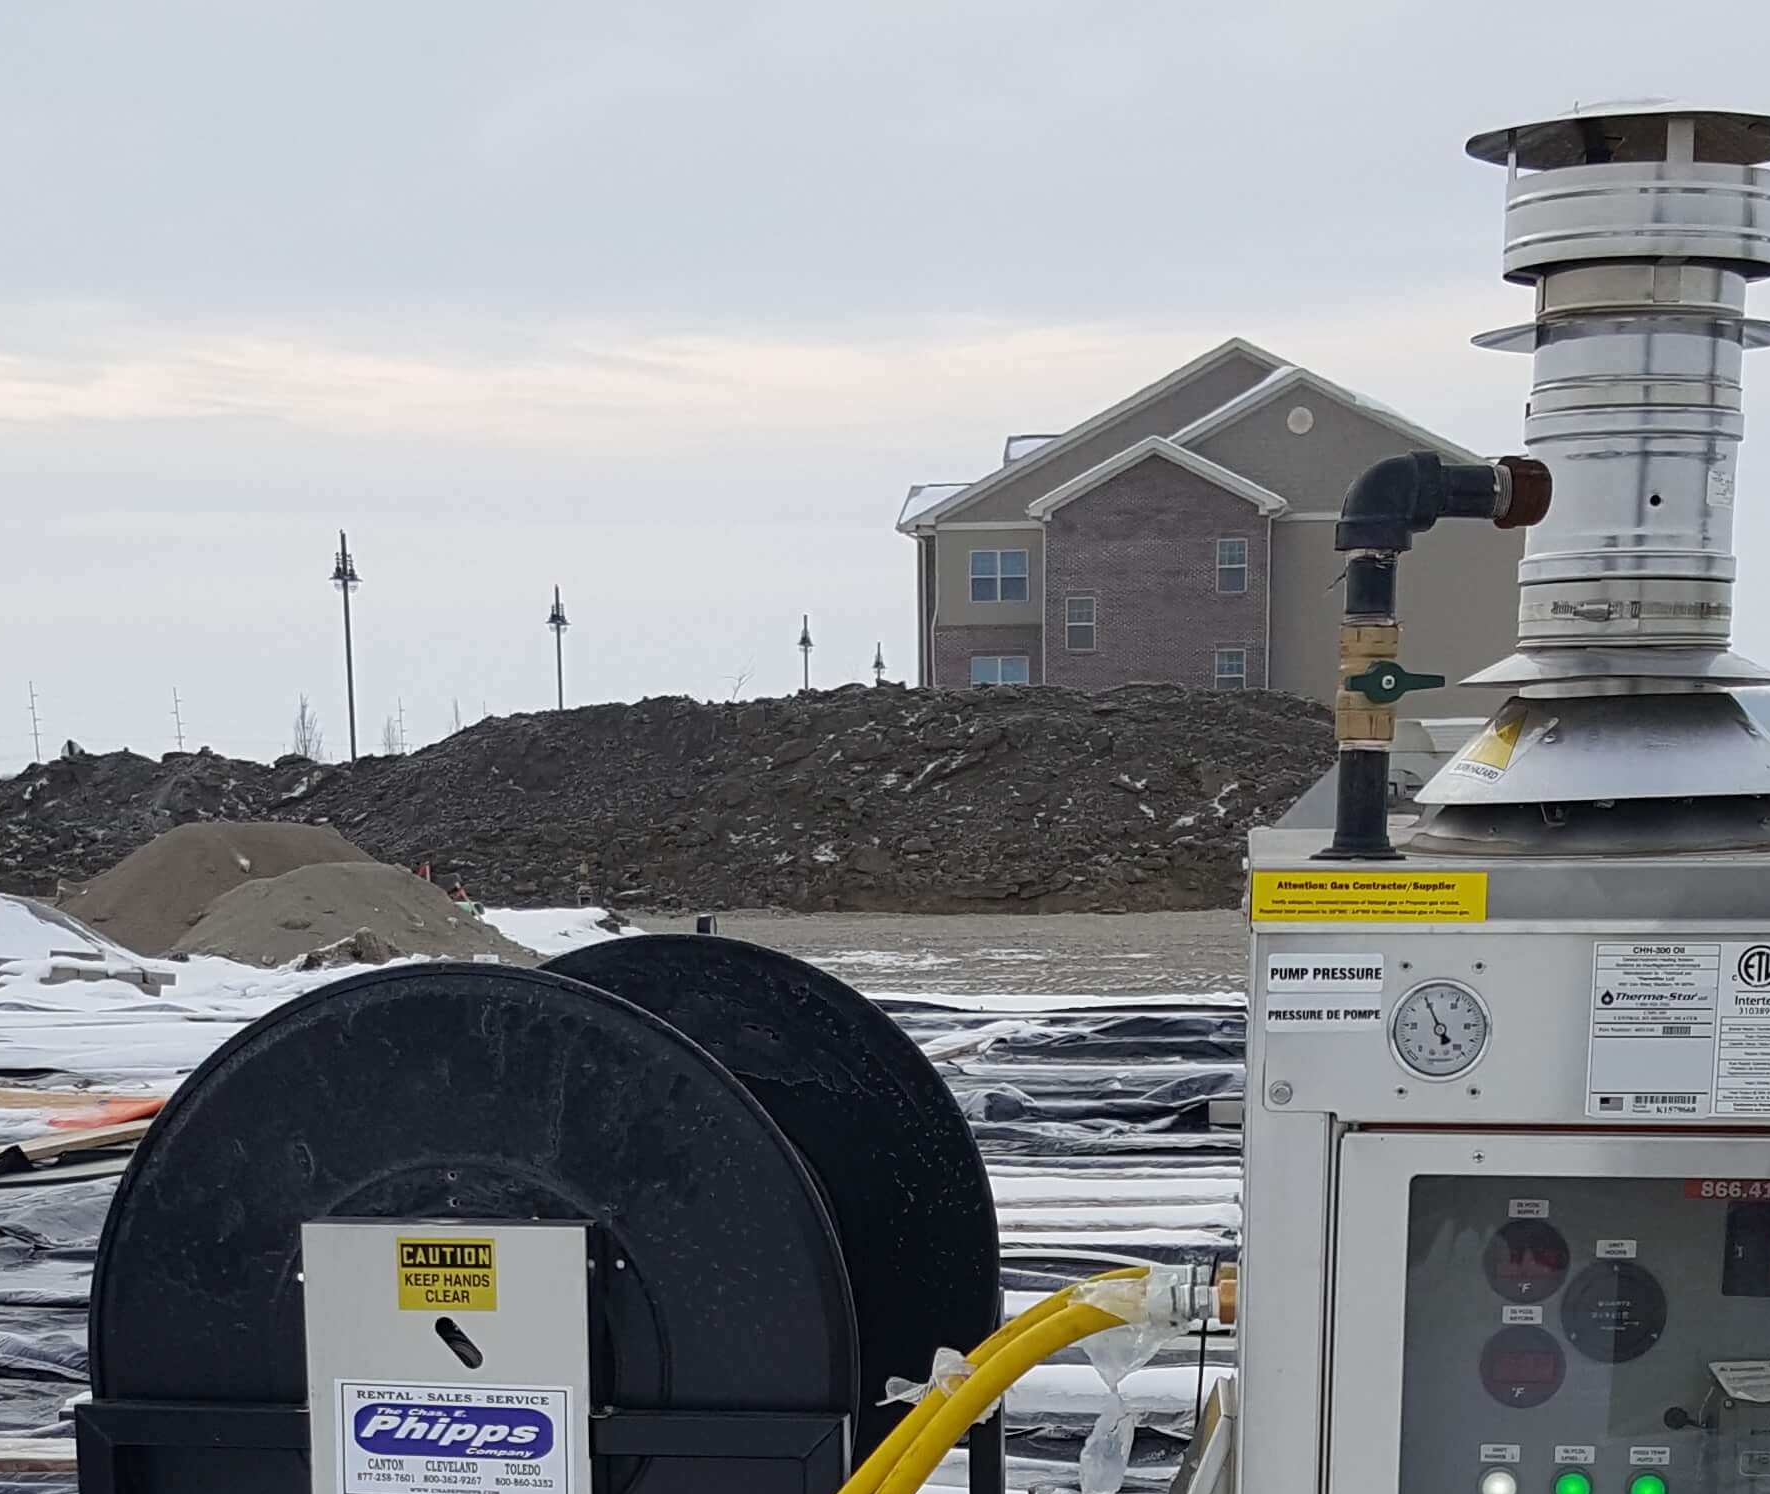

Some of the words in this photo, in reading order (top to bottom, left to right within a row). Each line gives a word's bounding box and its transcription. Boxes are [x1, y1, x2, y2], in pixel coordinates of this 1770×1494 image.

[1277, 881, 1328, 890] Attention:
[1331, 882, 1349, 890] Gas
[1353, 881, 1456, 893] Contractor/Supplier
[1271, 968, 1308, 980] PUMP
[1313, 968, 1382, 980] PRESSURE
[1615, 992, 1698, 1001] Therma-Stor
[1268, 1010, 1323, 1020] PRESSURE
[1326, 1010, 1341, 1020] DE
[1344, 1010, 1381, 1020] POMPE
[402, 1246, 490, 1266] CAUTION
[404, 1273, 440, 1287] KEEP
[443, 1274, 490, 1288] HANDS
[425, 1289, 470, 1304] CLEAR
[357, 1390, 413, 1400] RENTAL
[428, 1394, 472, 1403] SALES
[486, 1395, 550, 1406] SERVICE
[377, 1407, 403, 1416] The
[408, 1408, 447, 1417] Chas.
[360, 1415, 540, 1447] Phipps
[466, 1447, 534, 1459] Company
[368, 1459, 404, 1471] CANTON
[426, 1460, 478, 1474] CLEVELAND
[504, 1463, 541, 1476] TOLEDO
[357, 1472, 415, 1483] 877-258-7601
